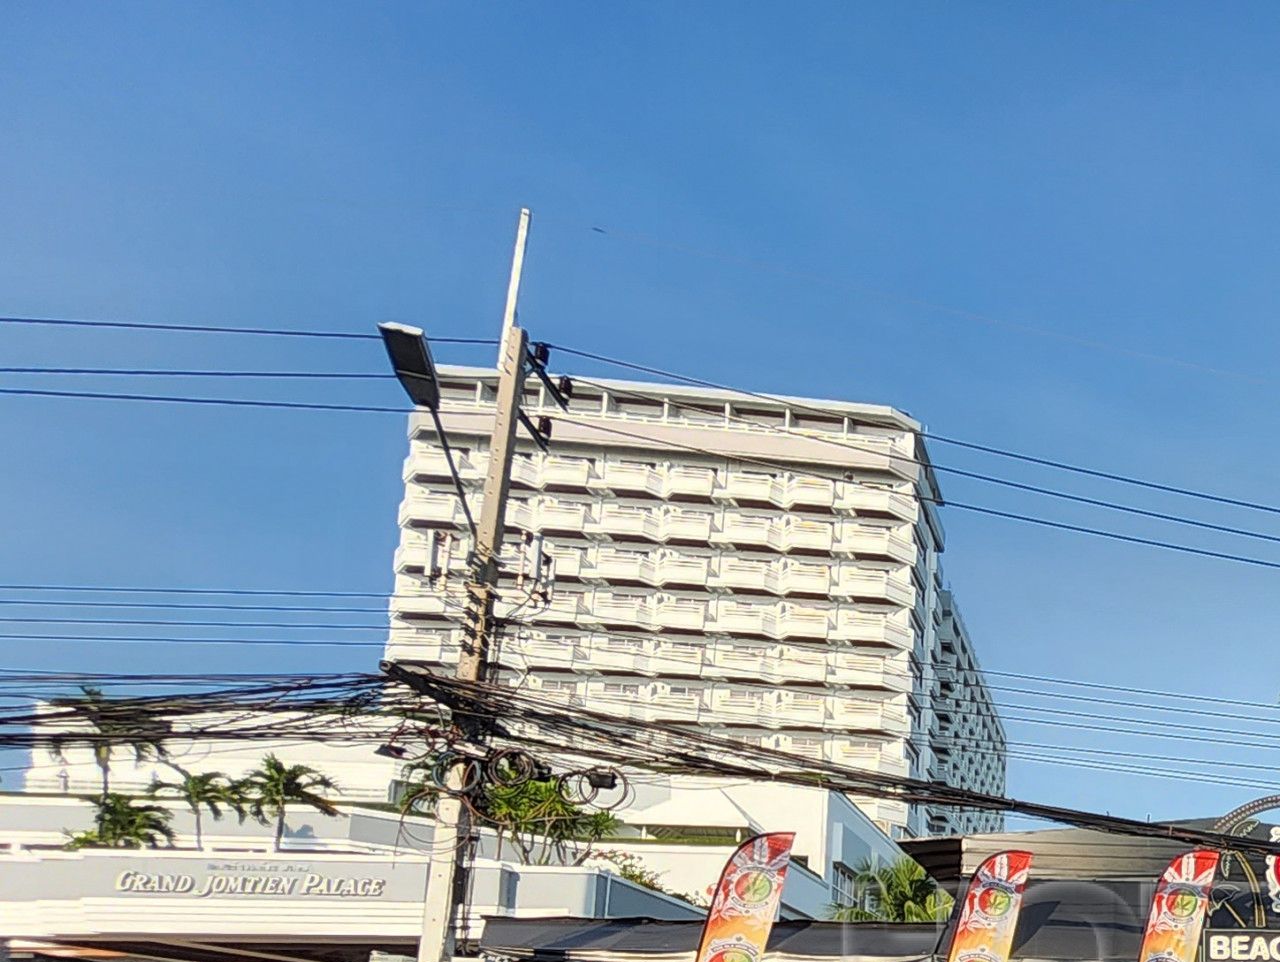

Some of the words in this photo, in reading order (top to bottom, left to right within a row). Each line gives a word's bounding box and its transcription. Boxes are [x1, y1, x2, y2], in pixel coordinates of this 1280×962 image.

[115, 870, 195, 893] GRAND
[195, 873, 297, 897] JOMTIEN
[299, 873, 385, 897] PALACE
